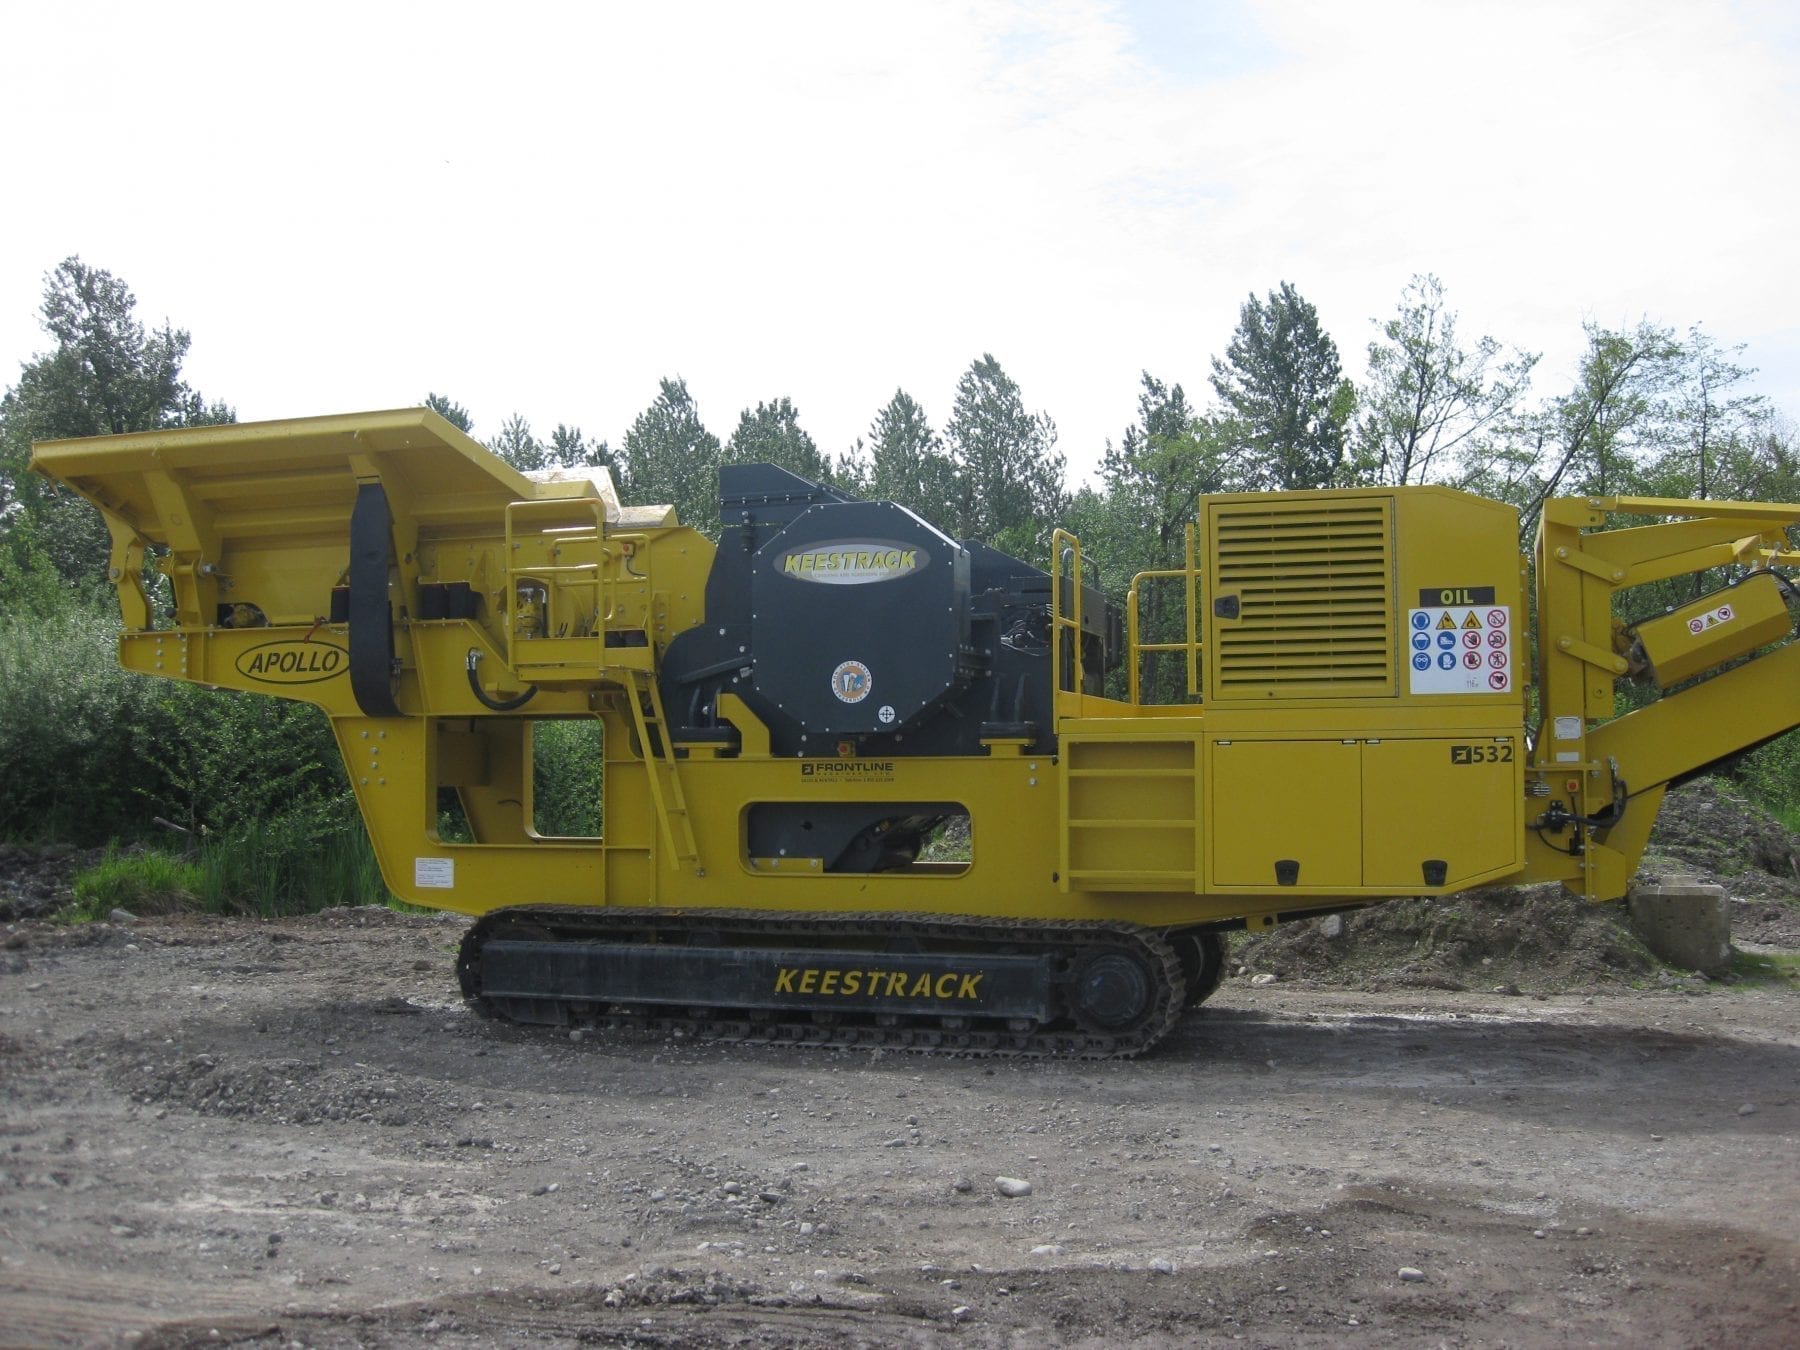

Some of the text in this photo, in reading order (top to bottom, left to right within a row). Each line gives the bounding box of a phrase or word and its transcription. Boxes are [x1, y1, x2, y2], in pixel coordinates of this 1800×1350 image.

[784, 550, 917, 573] KEESTRACK
[1440, 589, 1474, 604] OIL
[248, 650, 340, 673] APOLLO
[1473, 745, 1513, 763] 532
[816, 762, 894, 772] FRONTLINE
[774, 968, 984, 999] KEESTRACK
